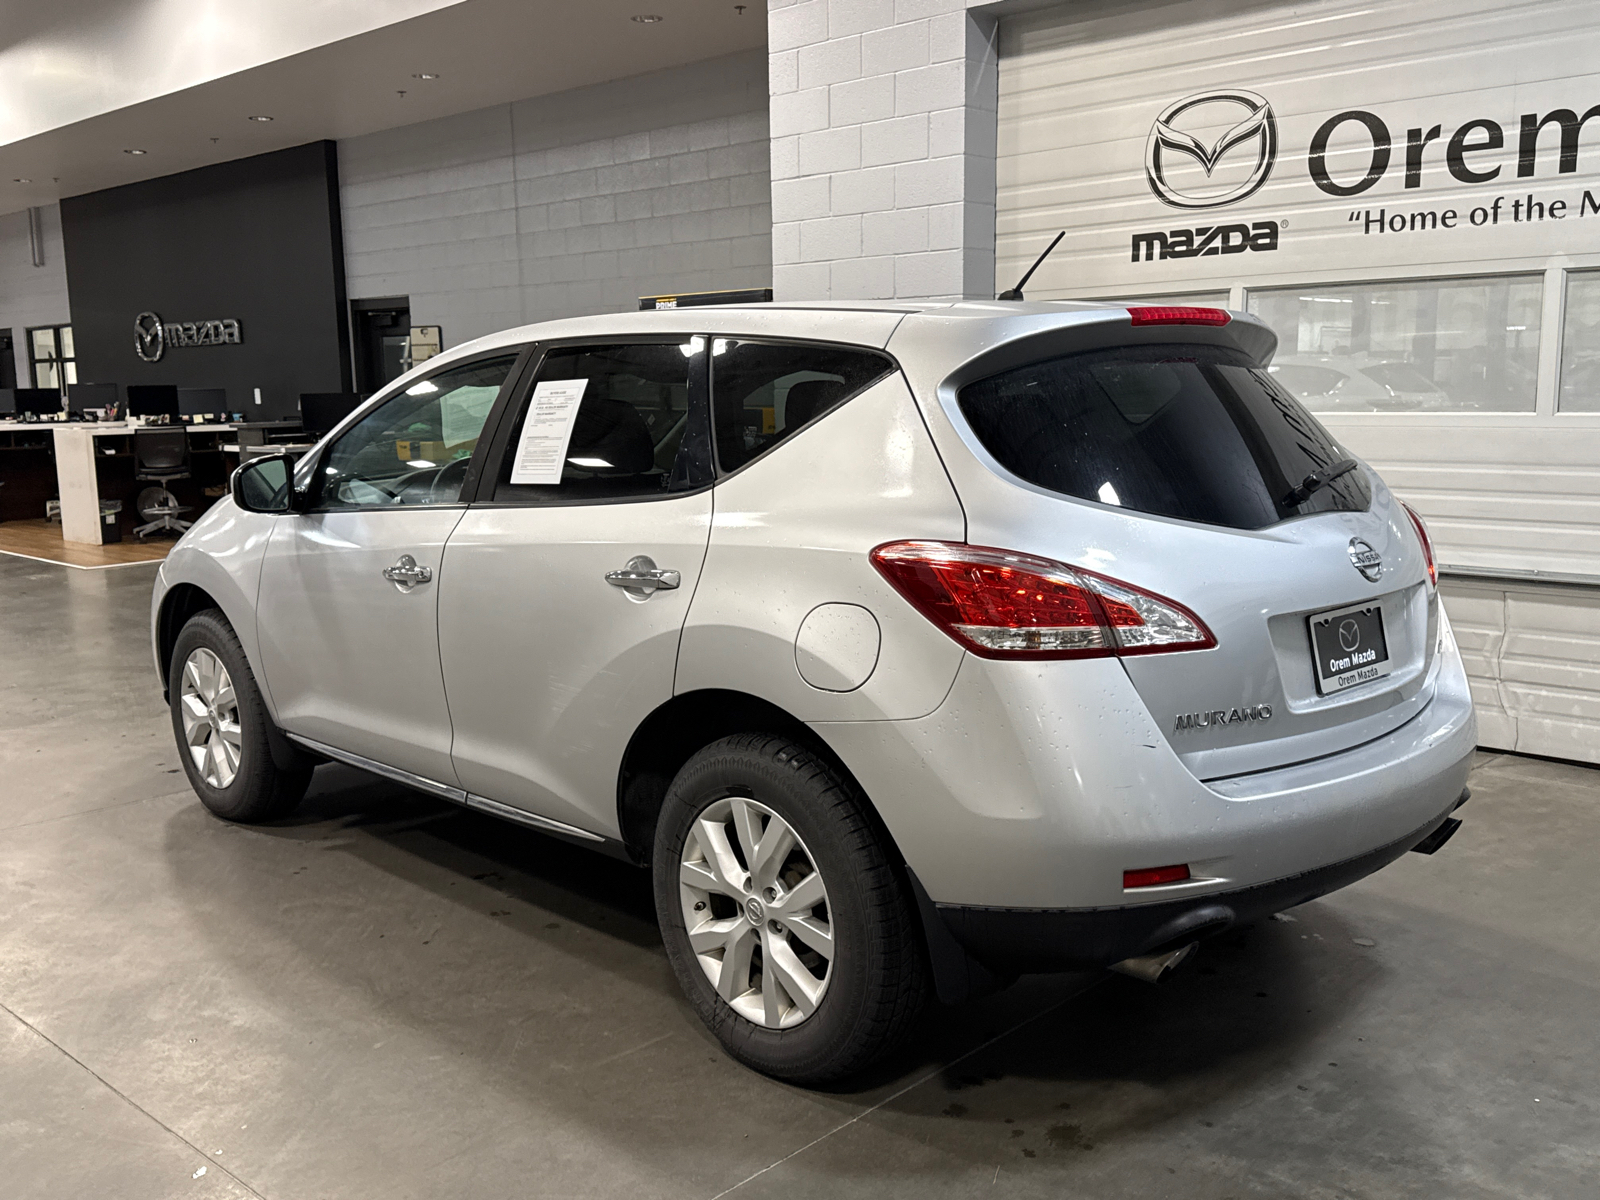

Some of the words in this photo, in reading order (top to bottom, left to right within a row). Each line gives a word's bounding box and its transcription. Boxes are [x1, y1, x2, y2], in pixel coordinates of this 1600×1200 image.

[1308, 104, 1600, 197] Orem
[1469, 197, 1504, 225] of
[1512, 194, 1567, 223] the
[1330, 657, 1351, 672] Orem
[1351, 648, 1376, 666] Mazda
[1338, 673, 1357, 687] Orem
[1356, 666, 1379, 680] Mazda
[1175, 704, 1272, 731] MURANO
